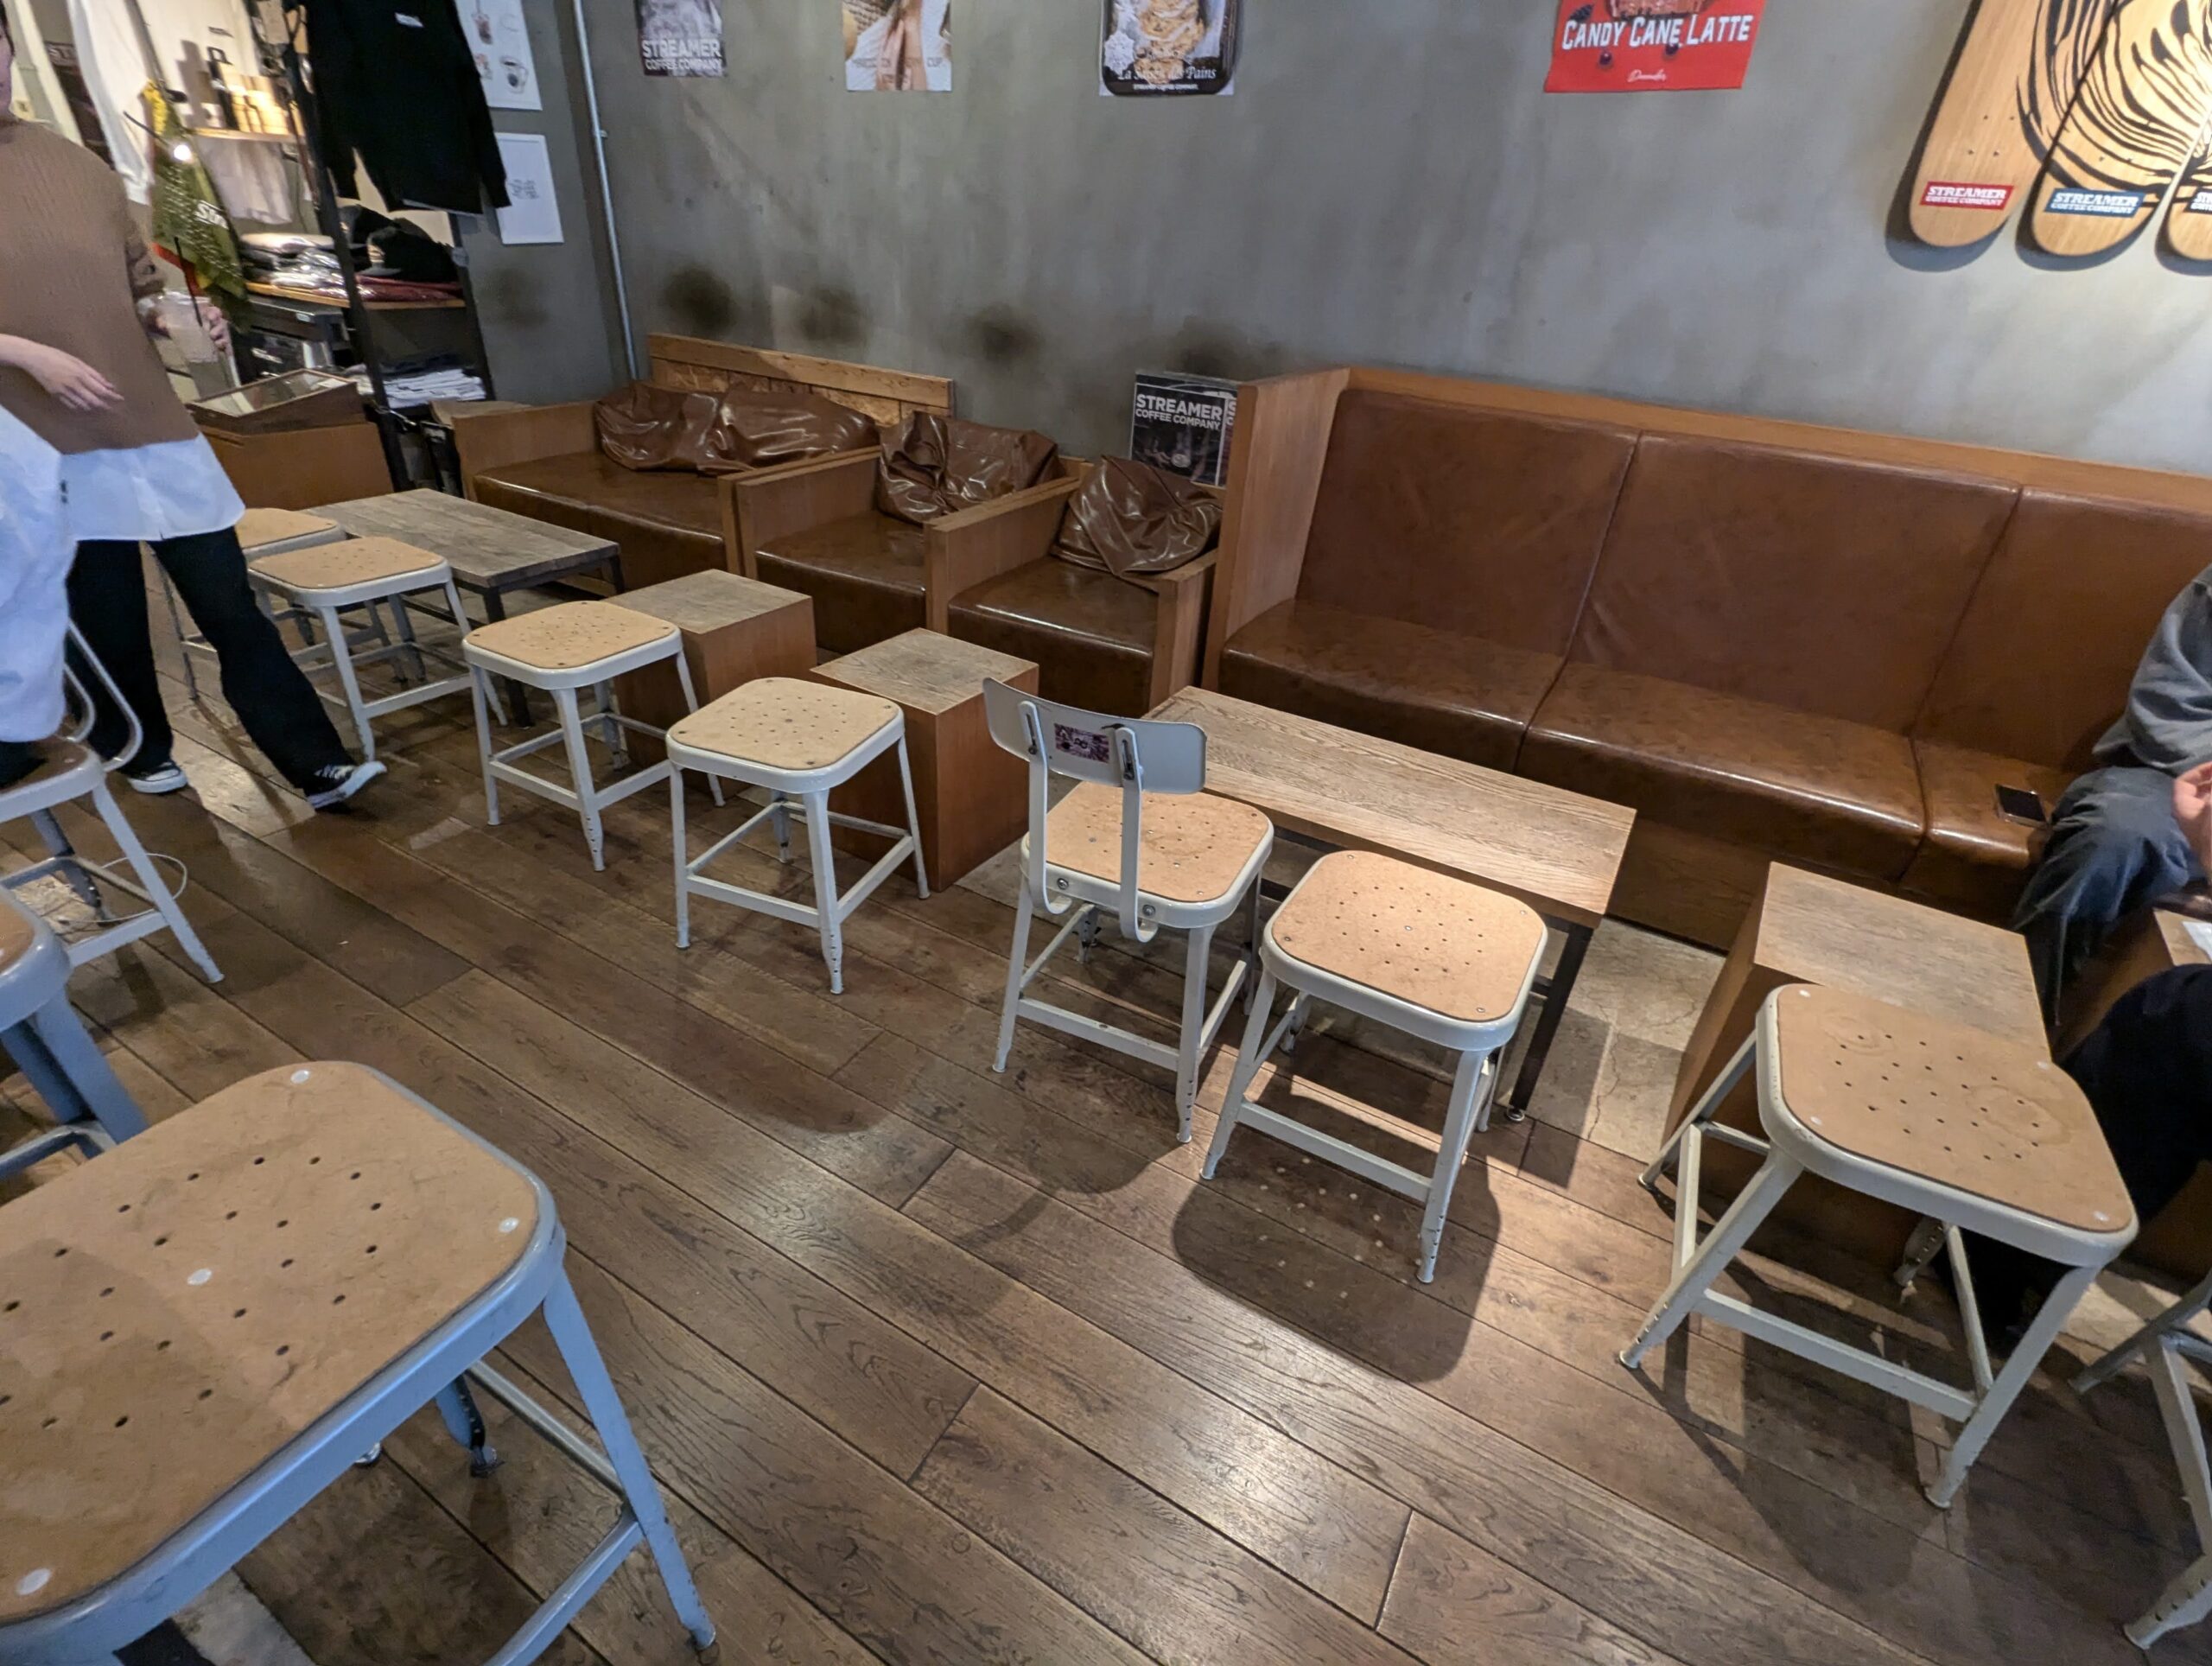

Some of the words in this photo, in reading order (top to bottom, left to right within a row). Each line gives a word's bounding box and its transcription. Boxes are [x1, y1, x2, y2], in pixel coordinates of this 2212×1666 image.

[1562, 20, 1627, 50] CANDY
[1629, 16, 1684, 47] CANE
[1686, 14, 1754, 46] LATTE
[642, 39, 722, 58] STREAMER
[1186, 66, 1217, 79] Pains
[1927, 186, 2007, 199] STREAMER
[2053, 192, 2139, 207] STREAMER
[1136, 393, 1224, 421] STREAMER
[1135, 409, 1172, 423] COFFEE
[1173, 415, 1221, 430] COMPANY
